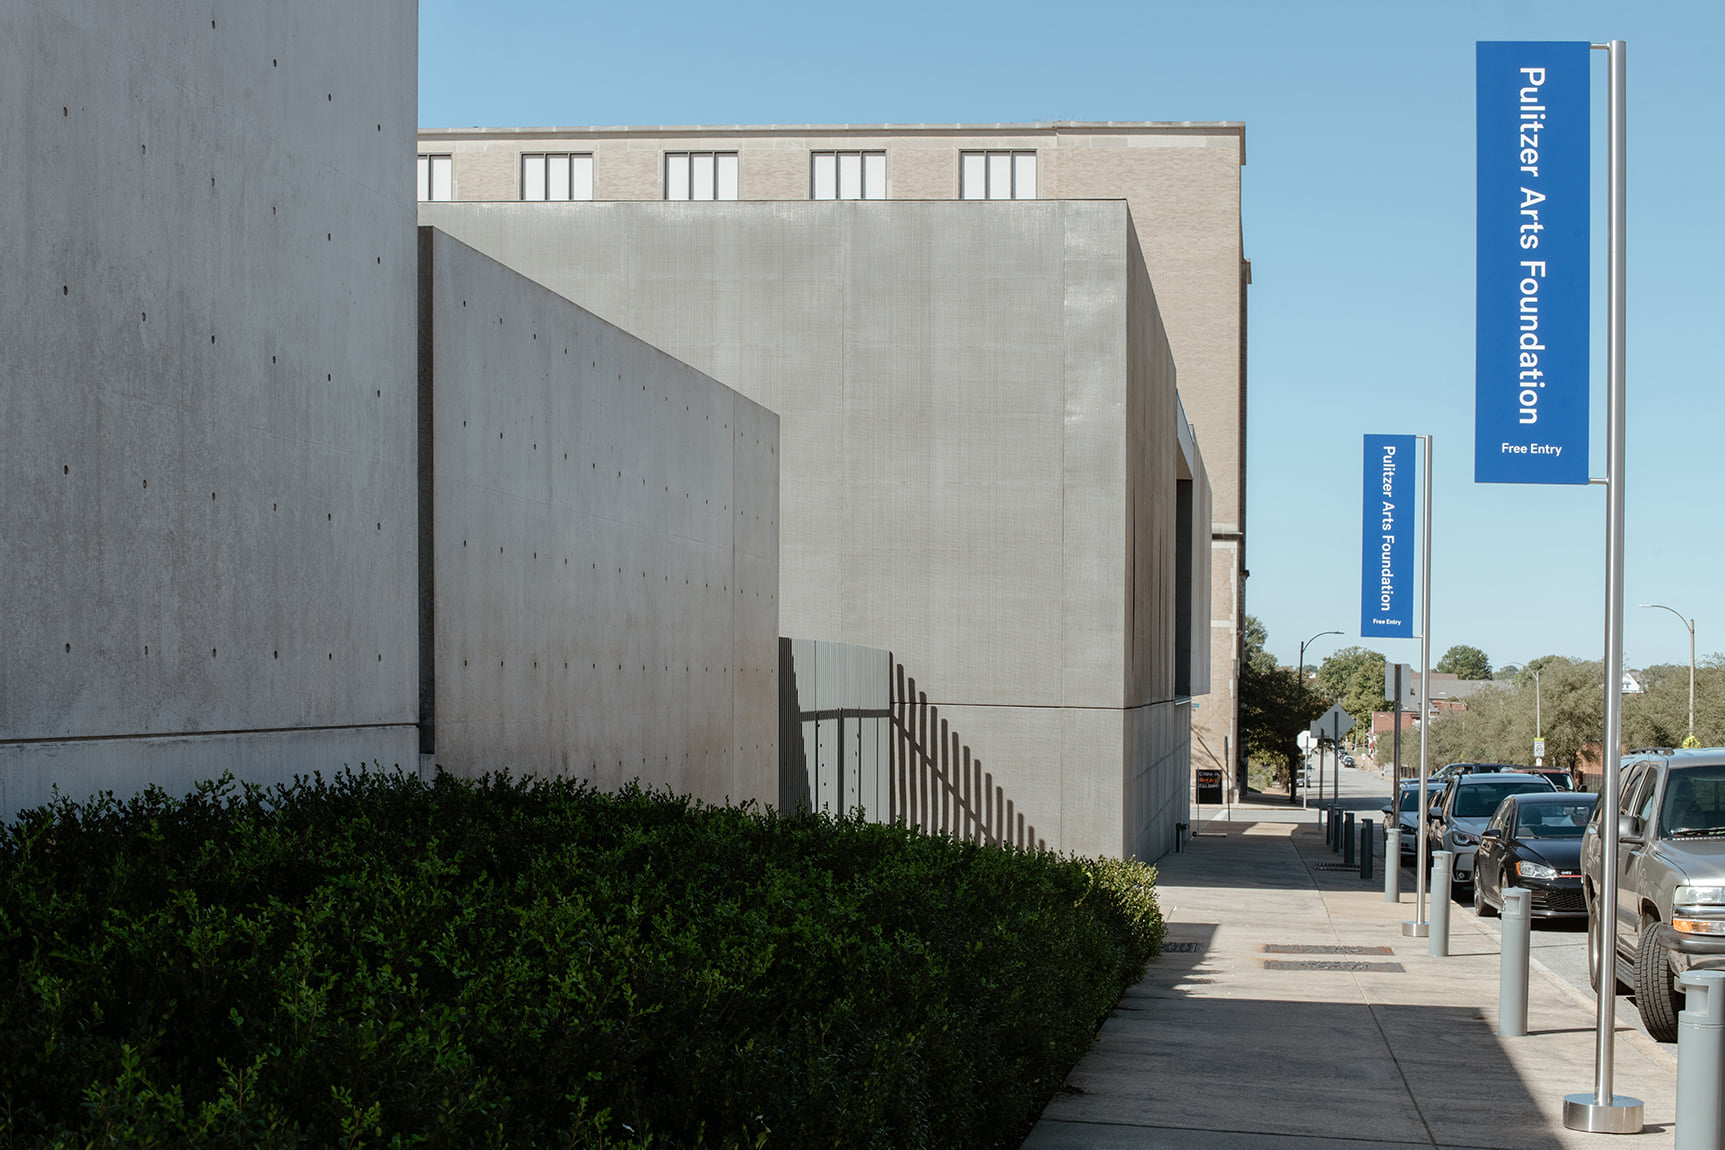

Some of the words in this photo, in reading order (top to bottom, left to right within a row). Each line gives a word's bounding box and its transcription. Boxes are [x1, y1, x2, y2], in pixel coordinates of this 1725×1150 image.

[1519, 67, 1547, 178] Pulitzer
[1519, 186, 1547, 250] Arts
[1518, 260, 1547, 425] Foundation
[1382, 445, 1397, 498] Pulitzer
[1501, 442, 1528, 455] Free
[1530, 442, 1563, 457] Entry
[1381, 500, 1396, 531] Arts
[1380, 534, 1396, 612] Foundation
[1386, 618, 1402, 626] Entry
